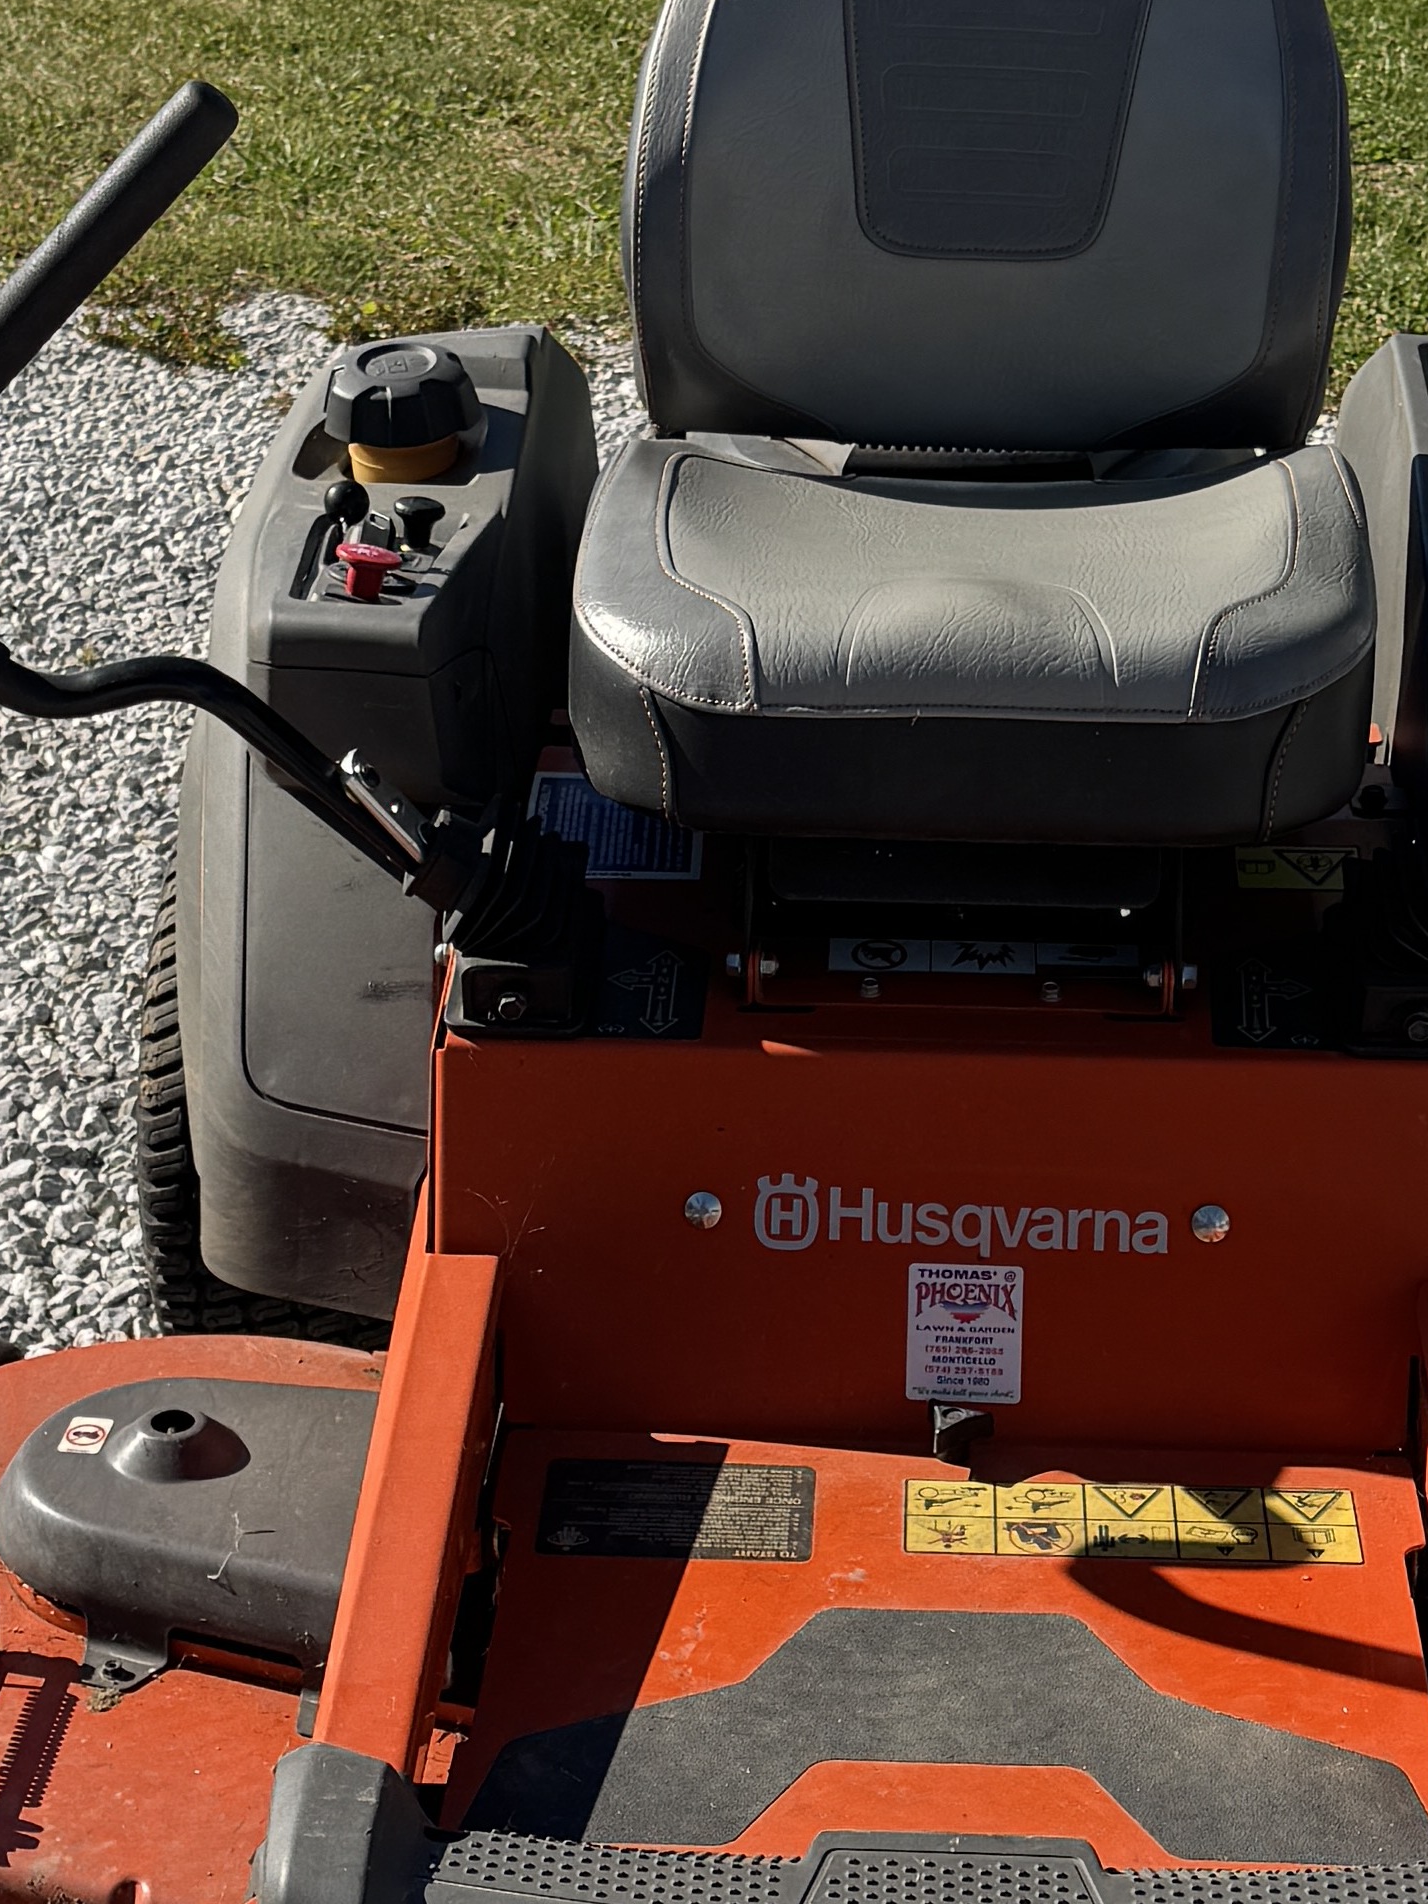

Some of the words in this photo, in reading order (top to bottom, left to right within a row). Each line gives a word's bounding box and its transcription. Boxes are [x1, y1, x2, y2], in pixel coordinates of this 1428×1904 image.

[828, 1186, 1169, 1258] Husqvarna
[1004, 1270, 1016, 1283] @
[915, 1281, 1018, 1322] PHOENIX
[916, 1324, 954, 1332] LAWN
[969, 1325, 1015, 1334] GARDEN
[935, 1335, 994, 1345] FRANKFORT
[931, 1355, 997, 1366] MONTICELLO
[936, 1375, 964, 1385] Since
